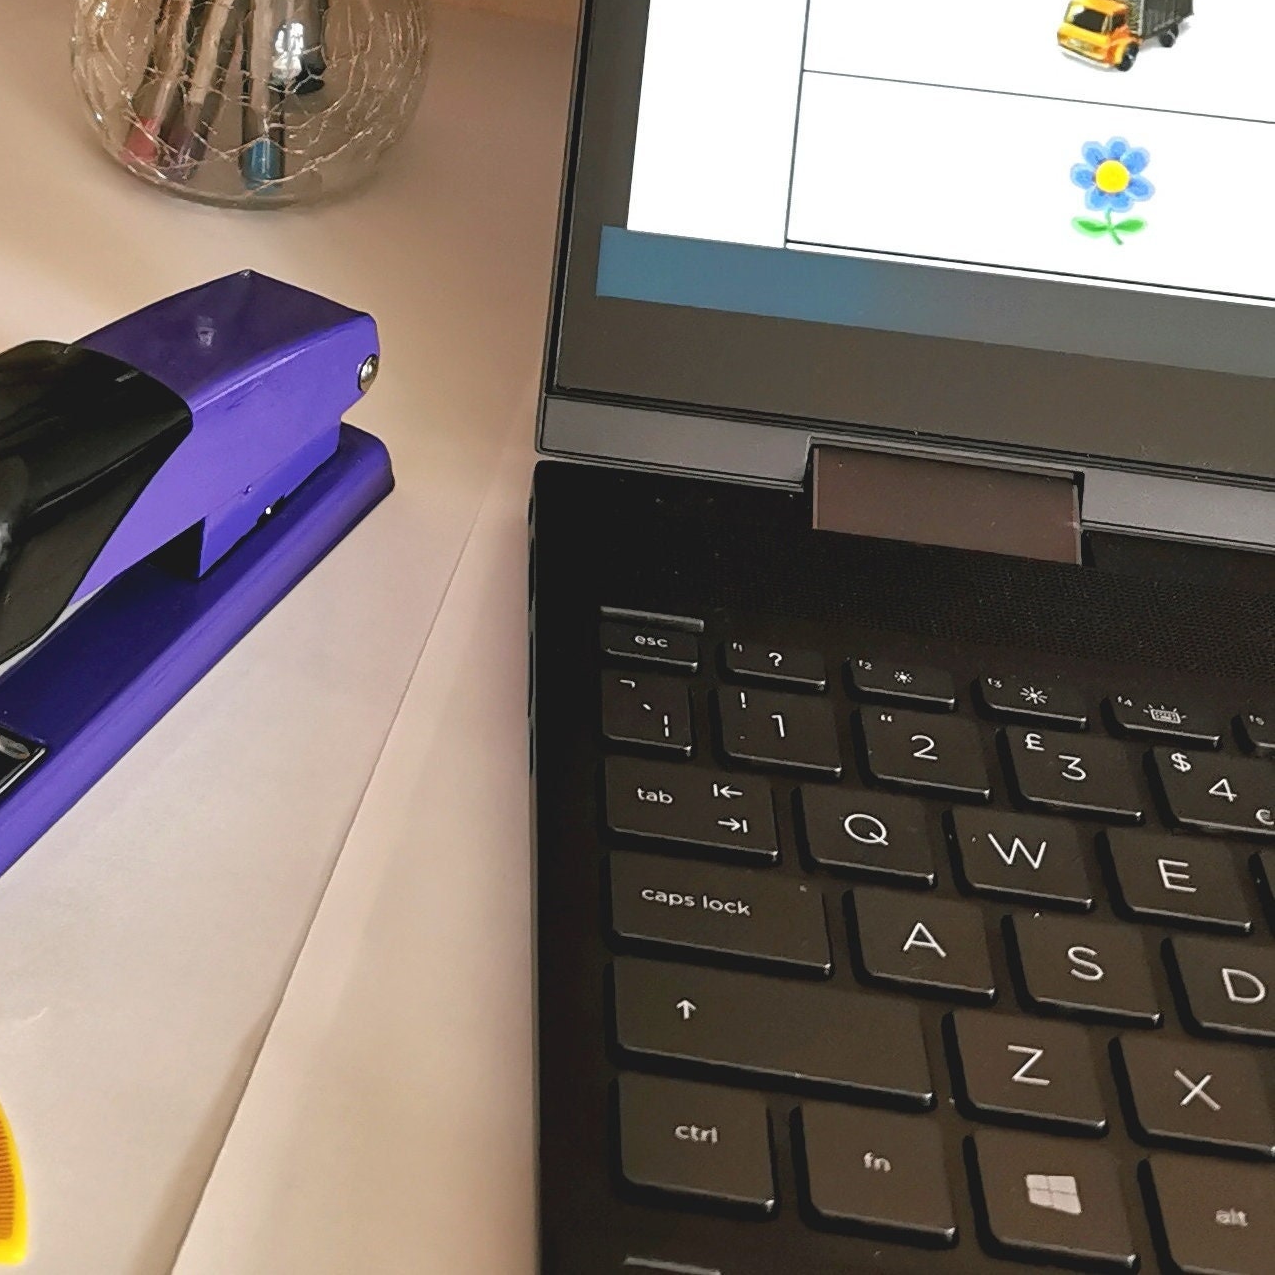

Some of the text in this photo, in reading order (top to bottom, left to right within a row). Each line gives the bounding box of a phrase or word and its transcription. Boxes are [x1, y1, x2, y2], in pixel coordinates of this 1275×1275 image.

[633, 633, 670, 649] esc
[910, 733, 939, 762] 2
[1058, 754, 1087, 782] 3
[636, 786, 674, 806] tab
[1208, 778, 1238, 802] 4
[843, 813, 889, 846] Q
[987, 832, 1047, 870] W
[1157, 858, 1198, 893] E
[640, 887, 752, 918] caps lock
[901, 921, 947, 958] A
[1066, 945, 1105, 982] S
[1221, 967, 1267, 1004] D
[1007, 1043, 1051, 1087] Z
[1174, 1068, 1222, 1111] X
[673, 1123, 720, 1145] ctrl
[862, 1151, 893, 1174] fn
[1214, 1207, 1249, 1228] alt
